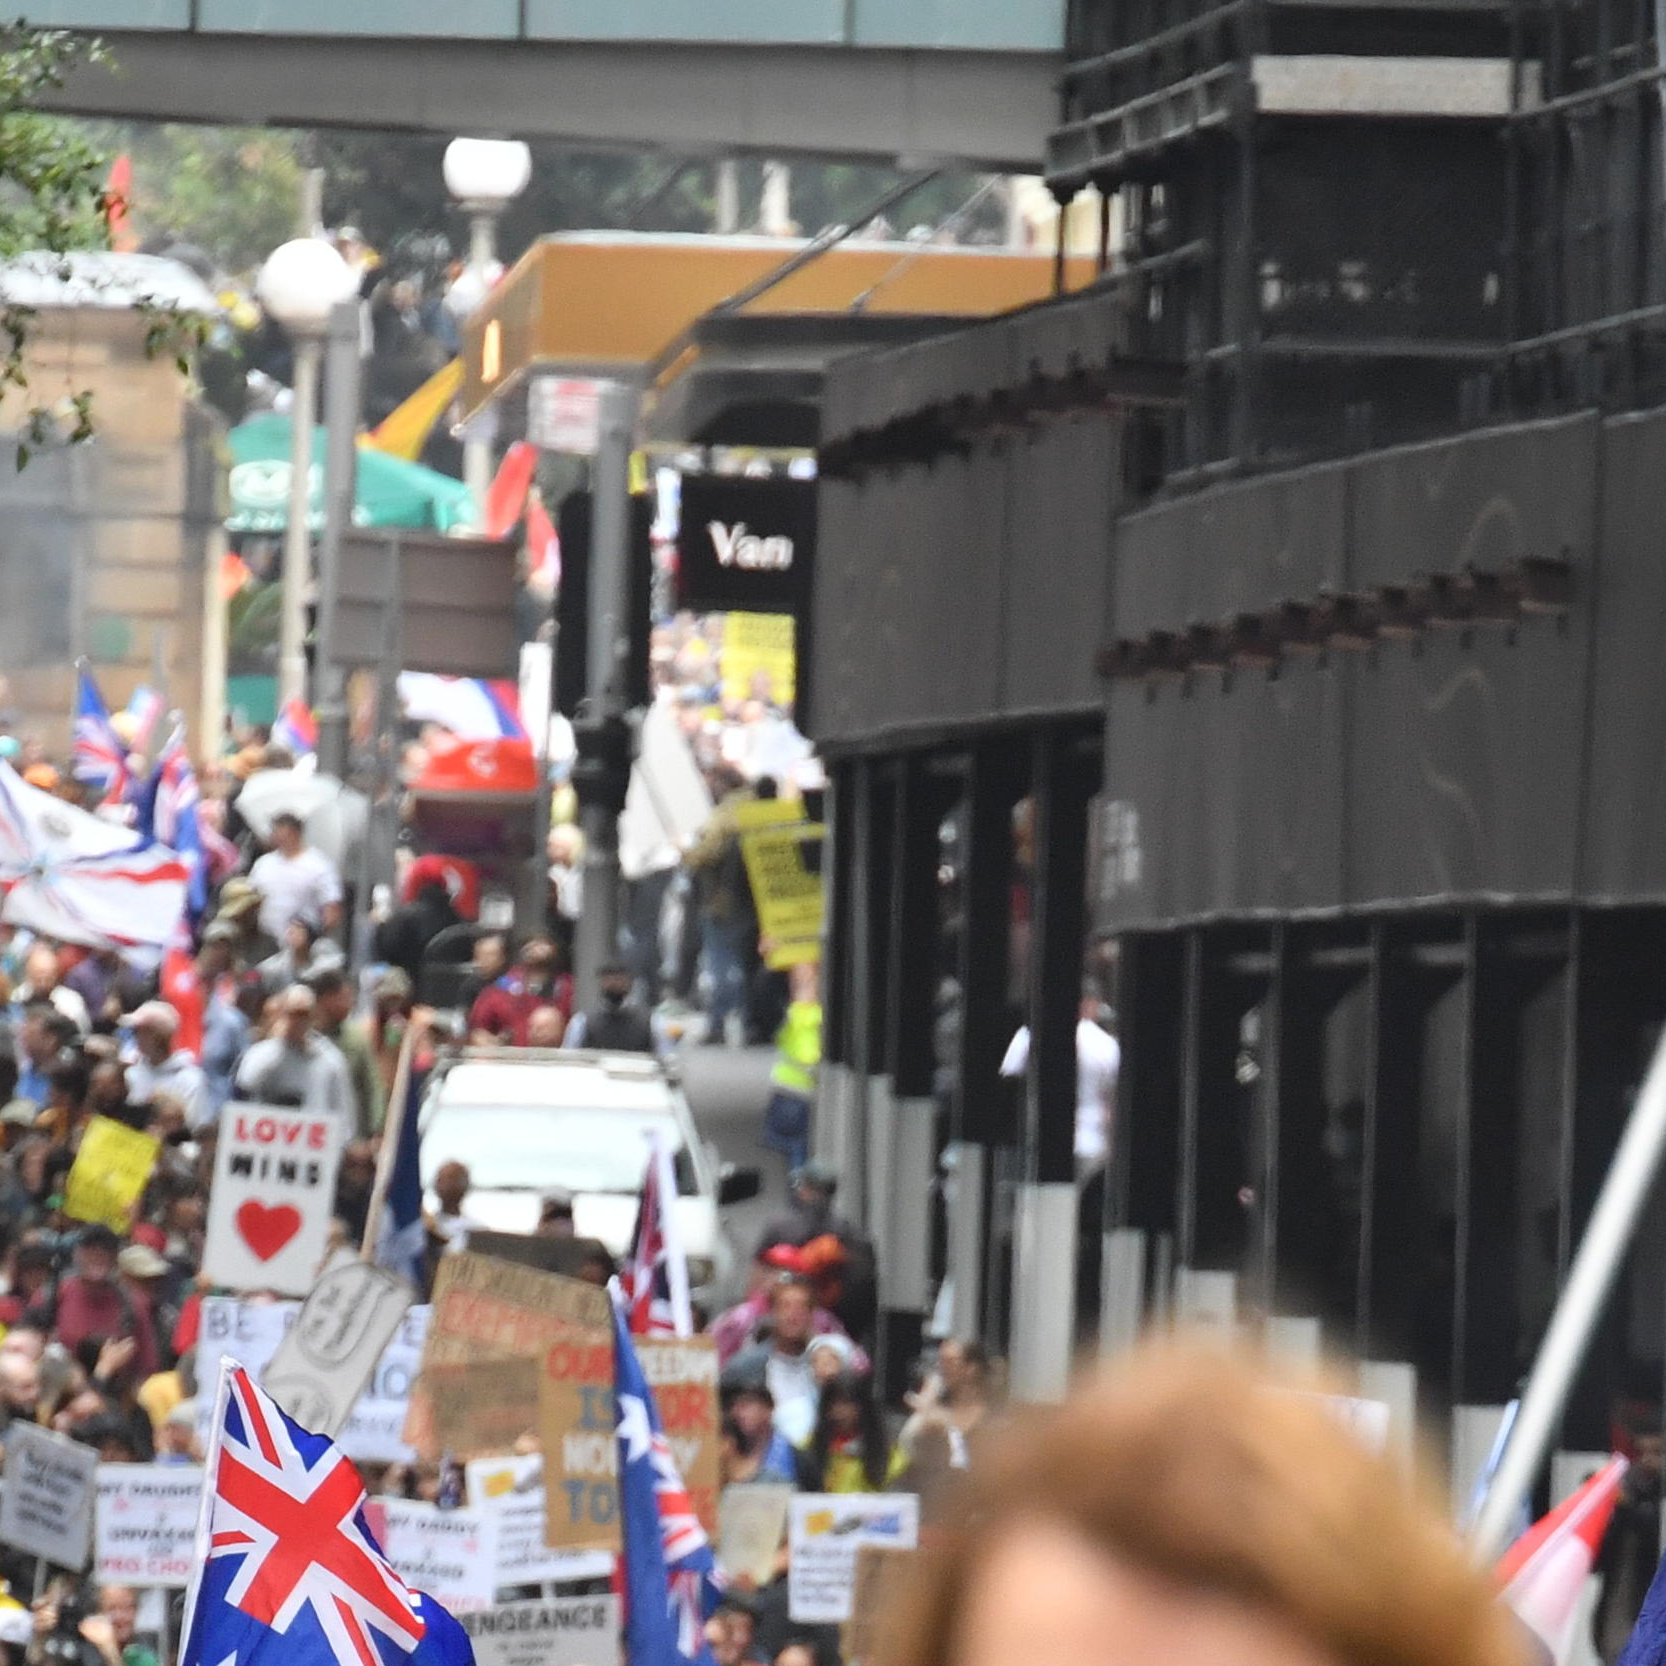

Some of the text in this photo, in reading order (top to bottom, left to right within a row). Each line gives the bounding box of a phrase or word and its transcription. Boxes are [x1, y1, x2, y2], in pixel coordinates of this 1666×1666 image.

[708, 521, 794, 570] Van
[236, 1114, 327, 1150] LOVE
[230, 1153, 320, 1186] WINS
[651, 1383, 710, 1431] OR
[561, 1479, 617, 1523] TO
[464, 1603, 607, 1635] ENGEANCE
